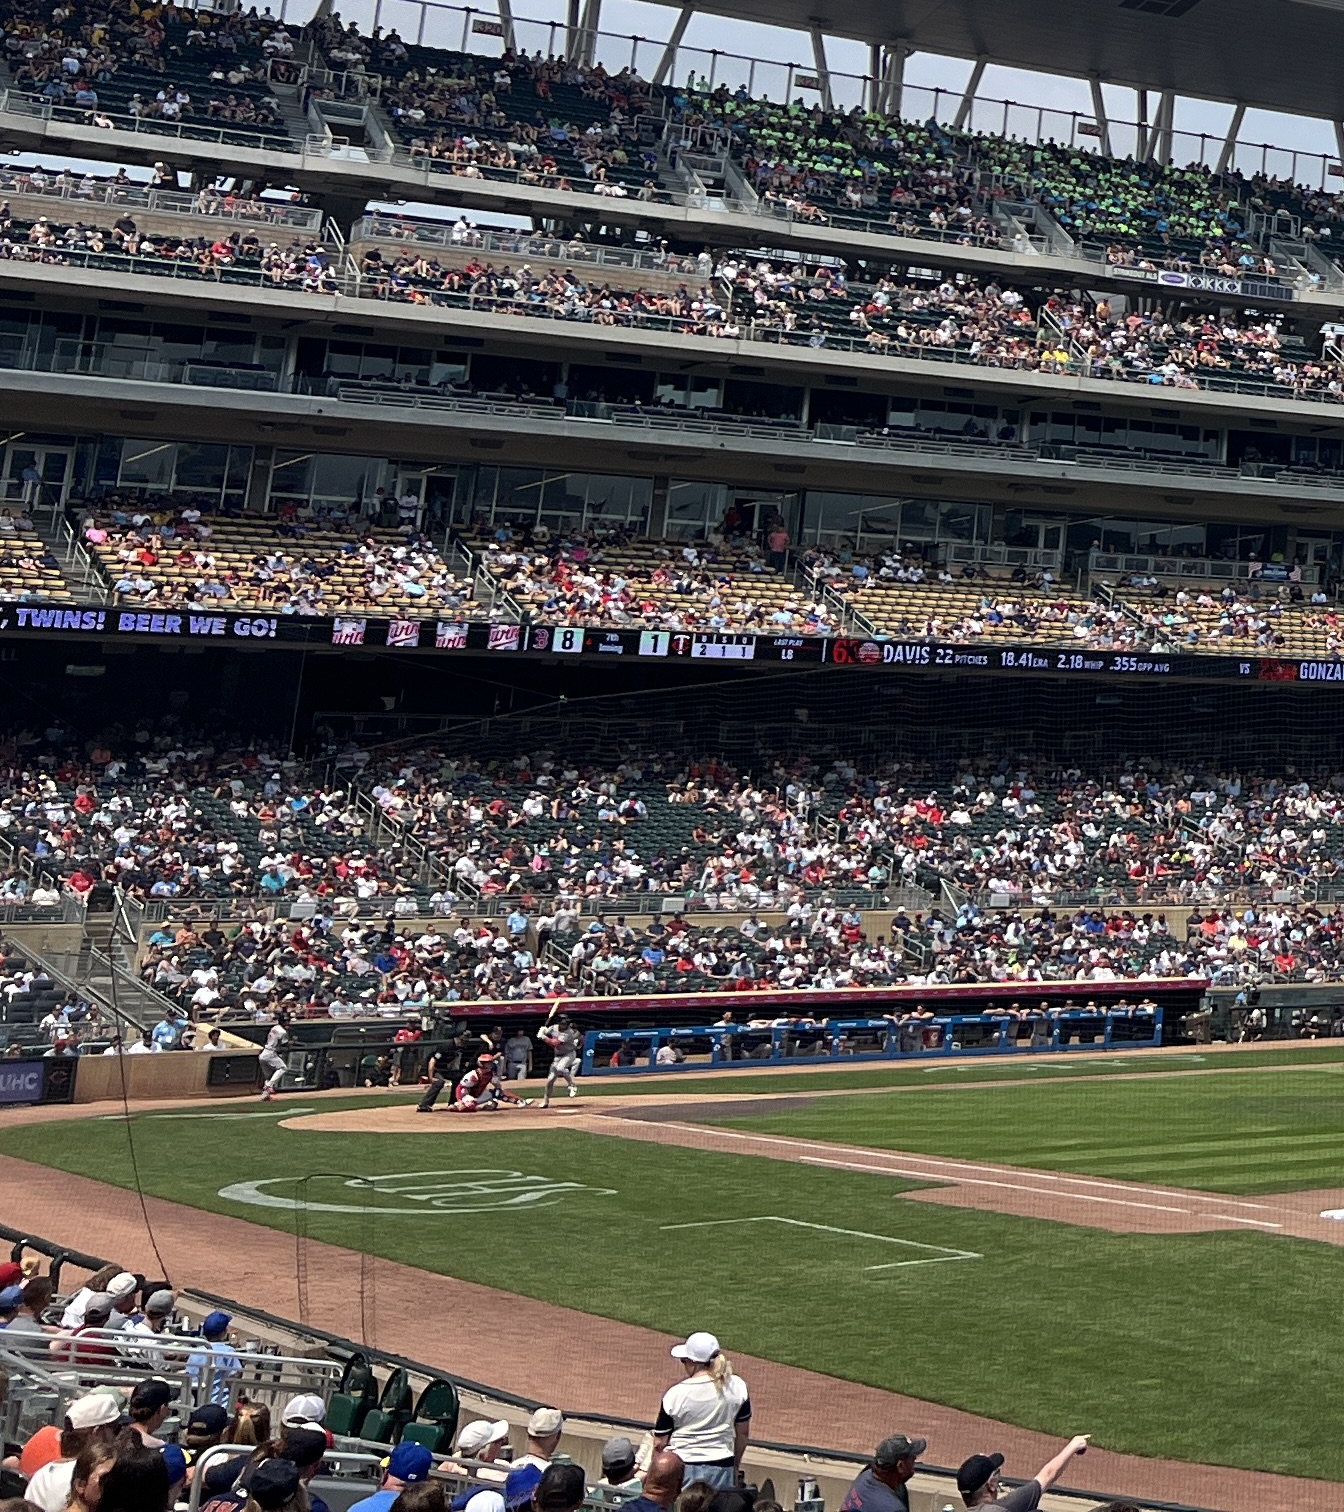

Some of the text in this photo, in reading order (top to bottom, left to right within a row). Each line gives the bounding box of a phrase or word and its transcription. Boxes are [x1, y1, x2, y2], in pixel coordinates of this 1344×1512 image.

[16, 607, 278, 638] TWINS! BEER WE GO!
[561, 628, 575, 650] 8
[651, 634, 660, 654] 1
[700, 644, 707, 656] 2
[883, 644, 930, 664] DAVIS
[935, 648, 954, 664] 22
[954, 654, 988, 666] PITCHES
